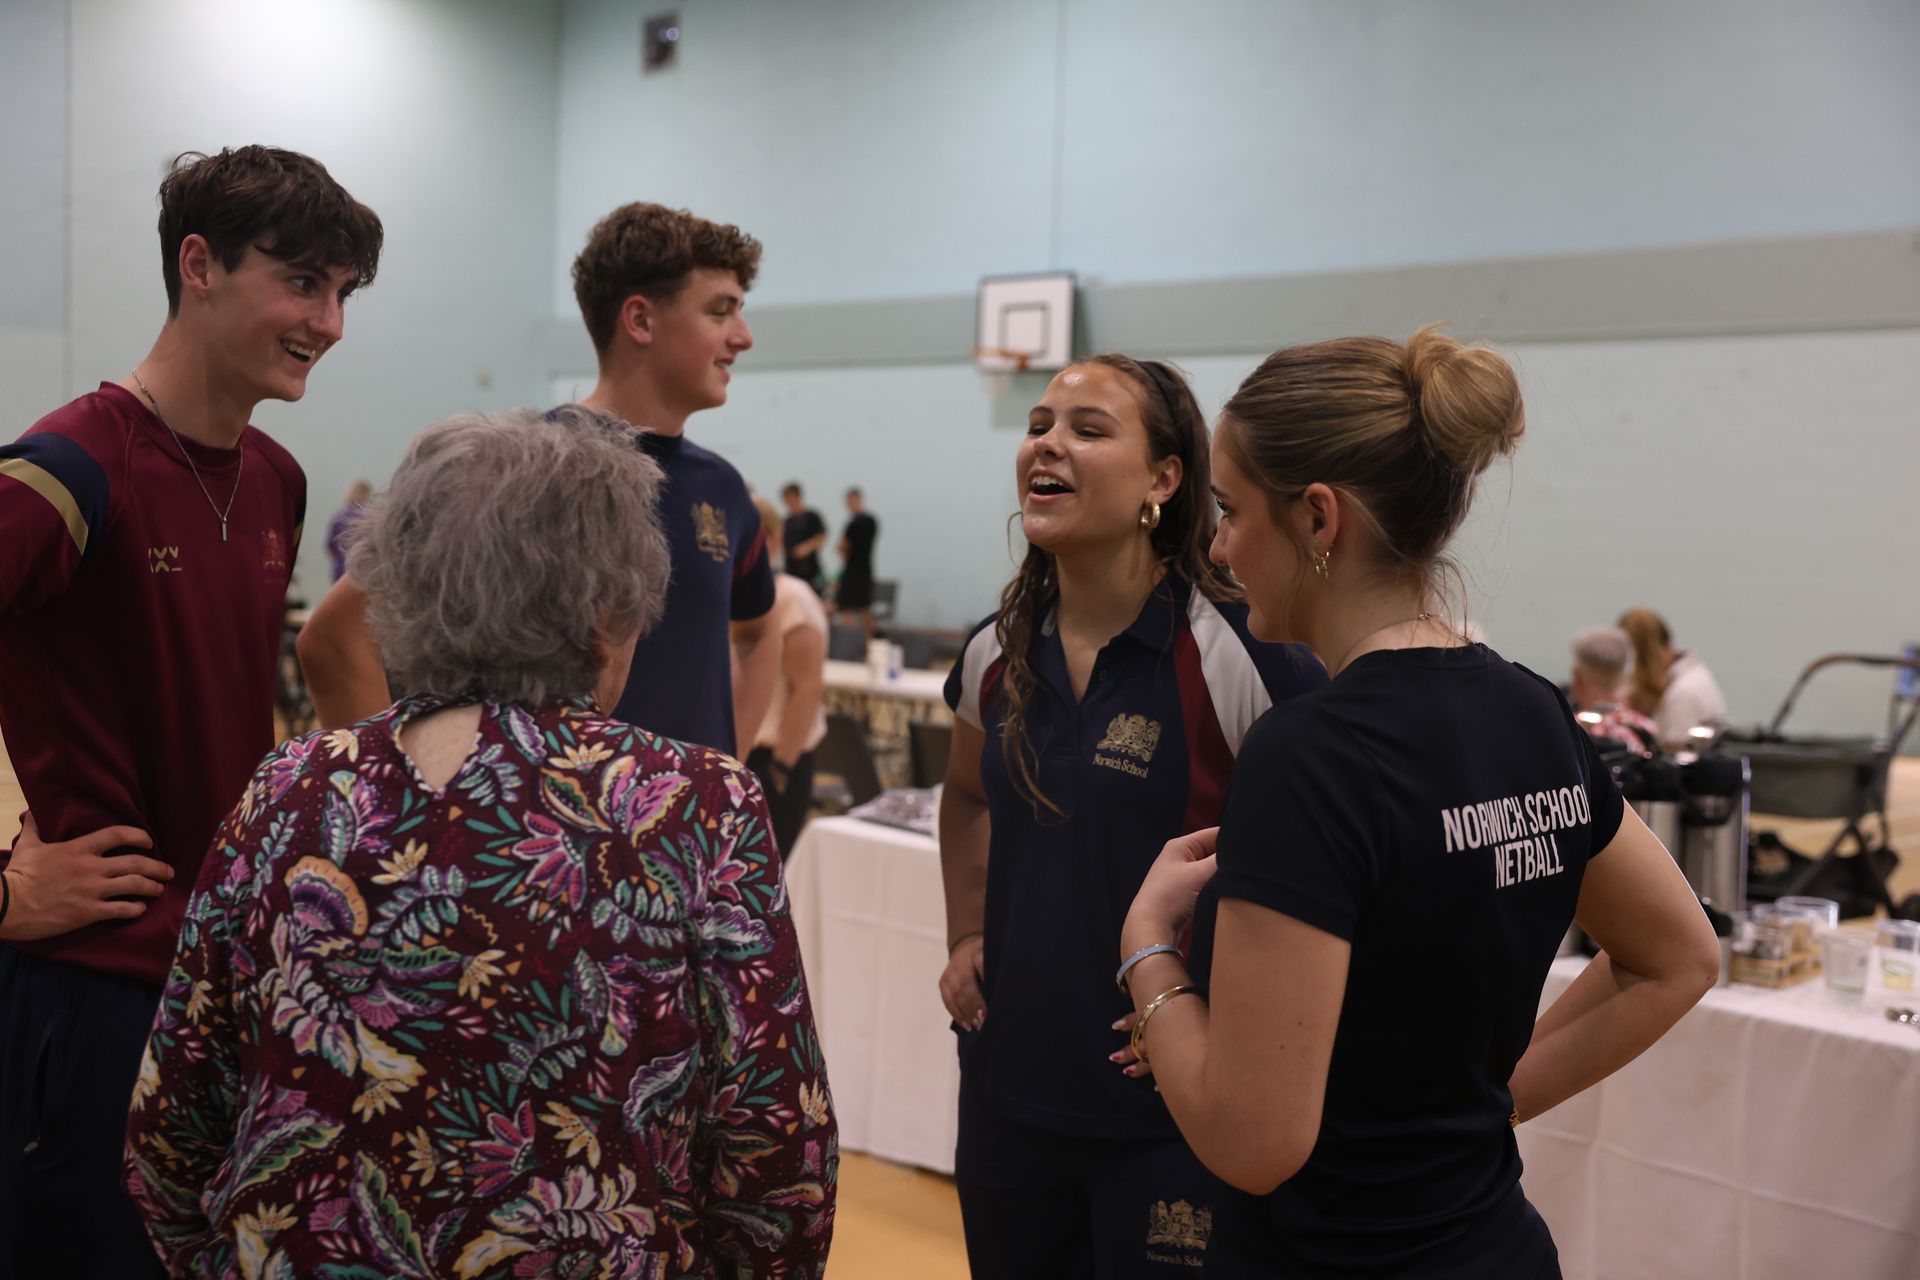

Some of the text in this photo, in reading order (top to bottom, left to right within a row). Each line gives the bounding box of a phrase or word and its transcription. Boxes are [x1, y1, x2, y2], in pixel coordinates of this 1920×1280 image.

[1121, 759, 1149, 779] School
[1441, 796, 1528, 853] NORWICH
[1494, 833, 1564, 889] NETBALL
